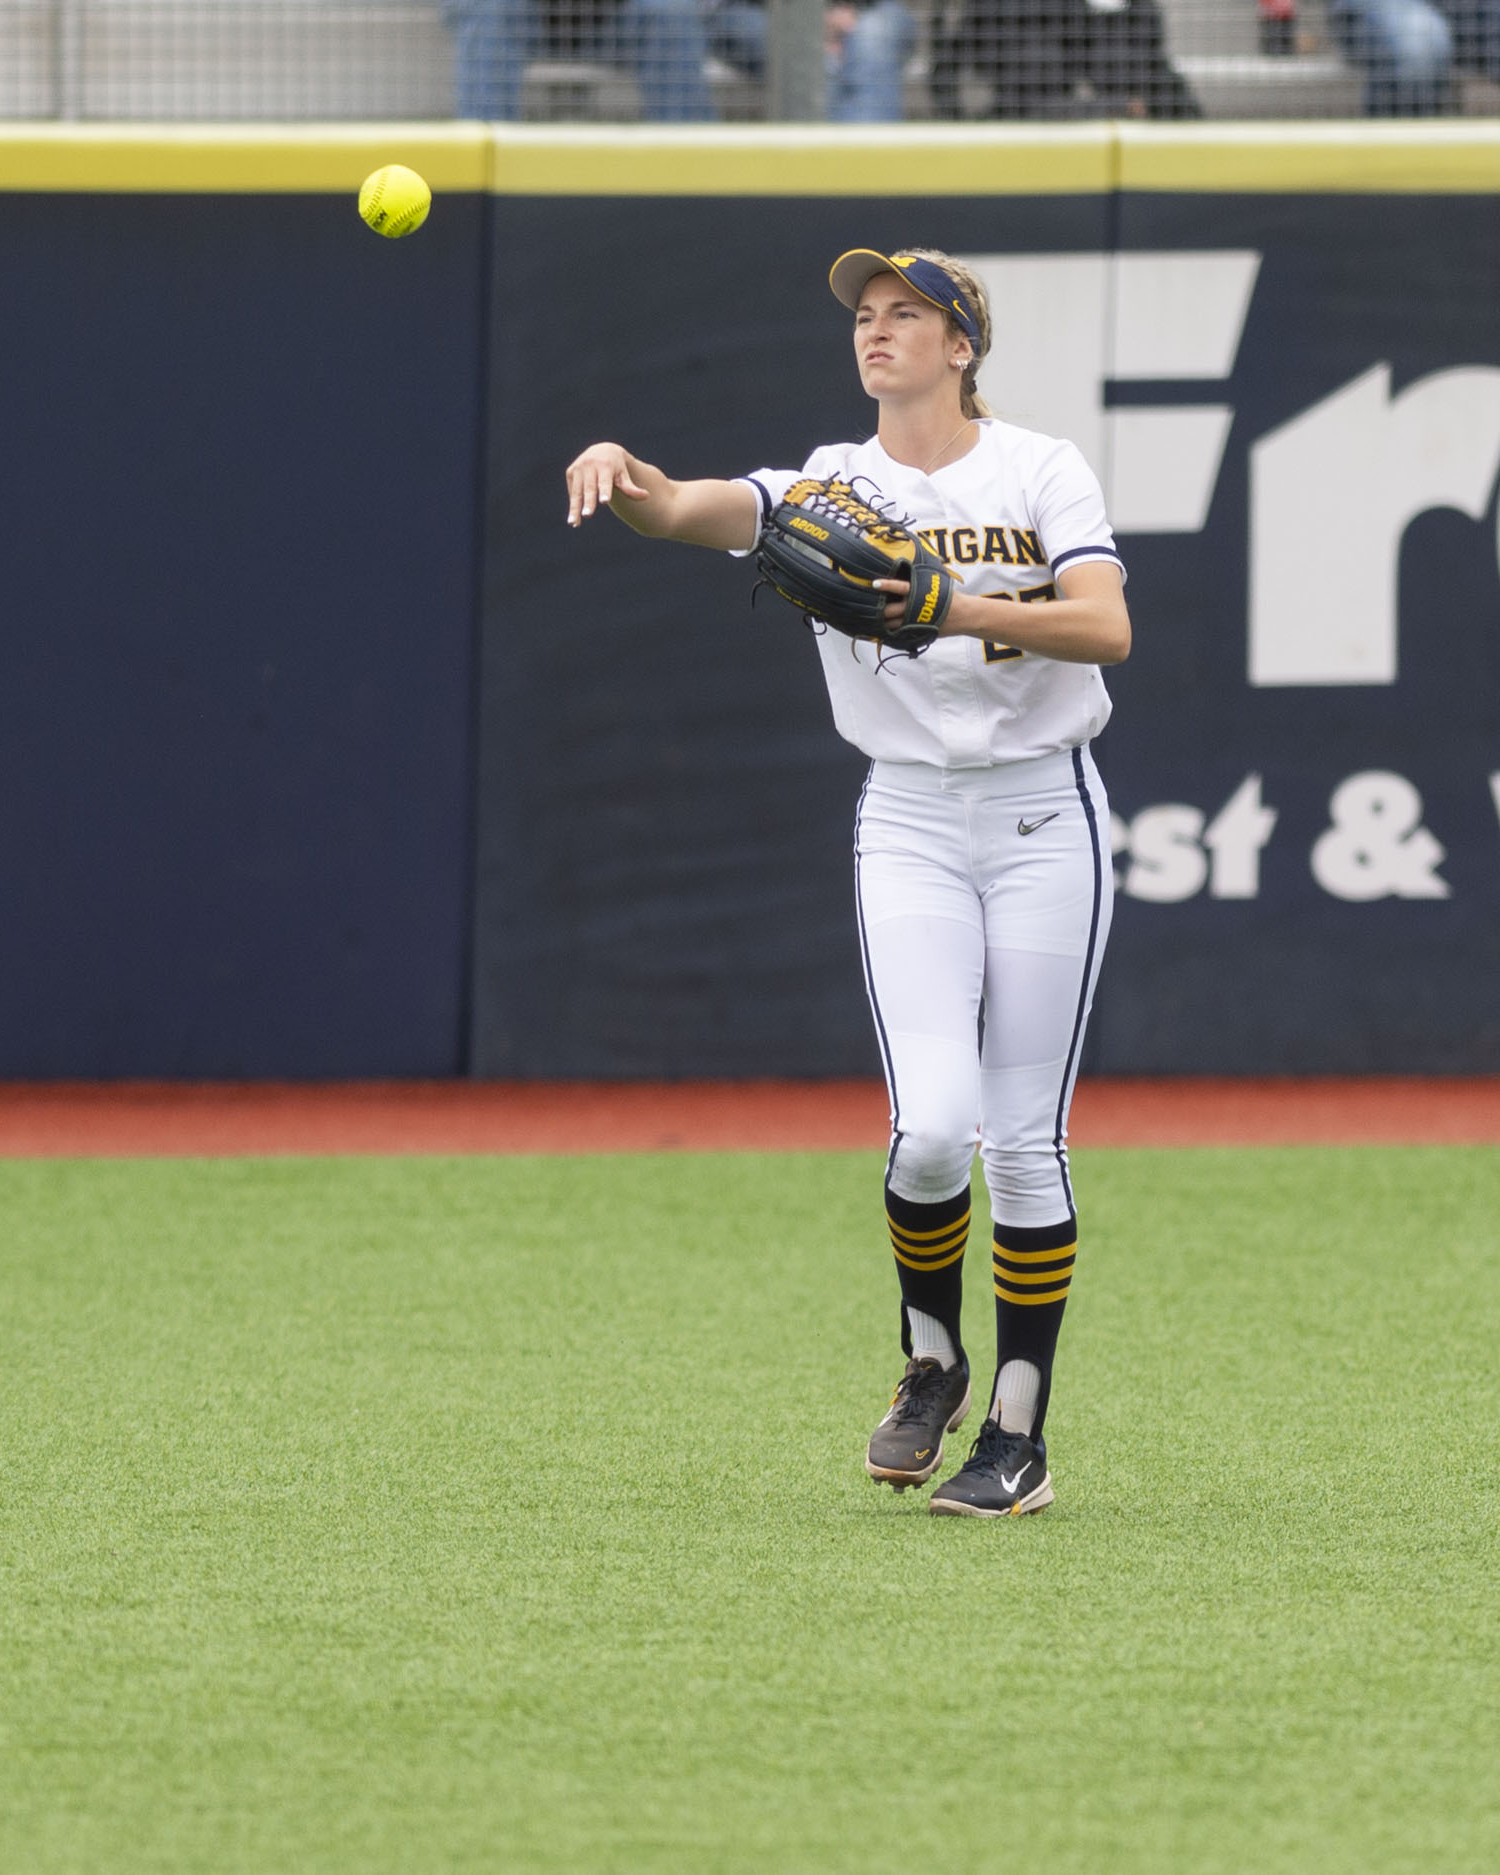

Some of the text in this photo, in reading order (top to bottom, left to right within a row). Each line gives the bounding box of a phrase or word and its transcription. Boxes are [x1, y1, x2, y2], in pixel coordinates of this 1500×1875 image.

[950, 250, 1500, 687] Fr
[788, 516, 831, 541] A2000
[916, 574, 941, 624] Wilson
[1310, 769, 1452, 903] &
